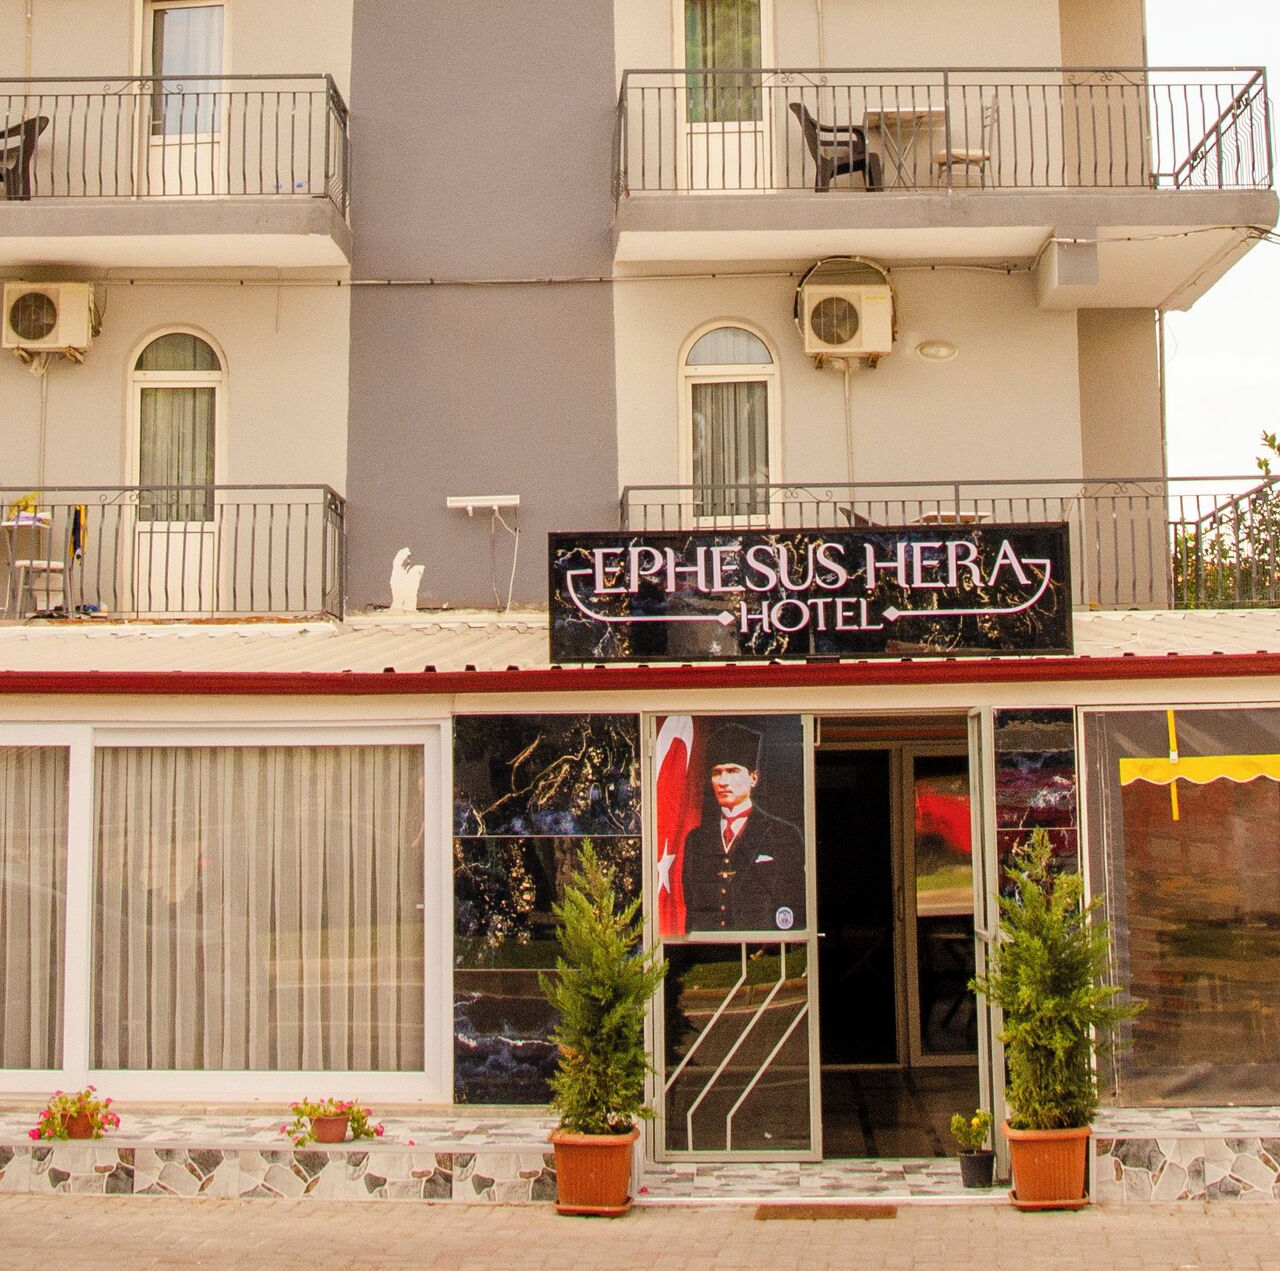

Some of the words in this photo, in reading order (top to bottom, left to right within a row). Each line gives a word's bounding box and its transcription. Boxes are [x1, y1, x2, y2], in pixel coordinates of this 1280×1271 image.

[593, 542, 848, 594] EPHESUS
[863, 539, 1032, 590] HERA
[739, 597, 884, 633] HOTEL
